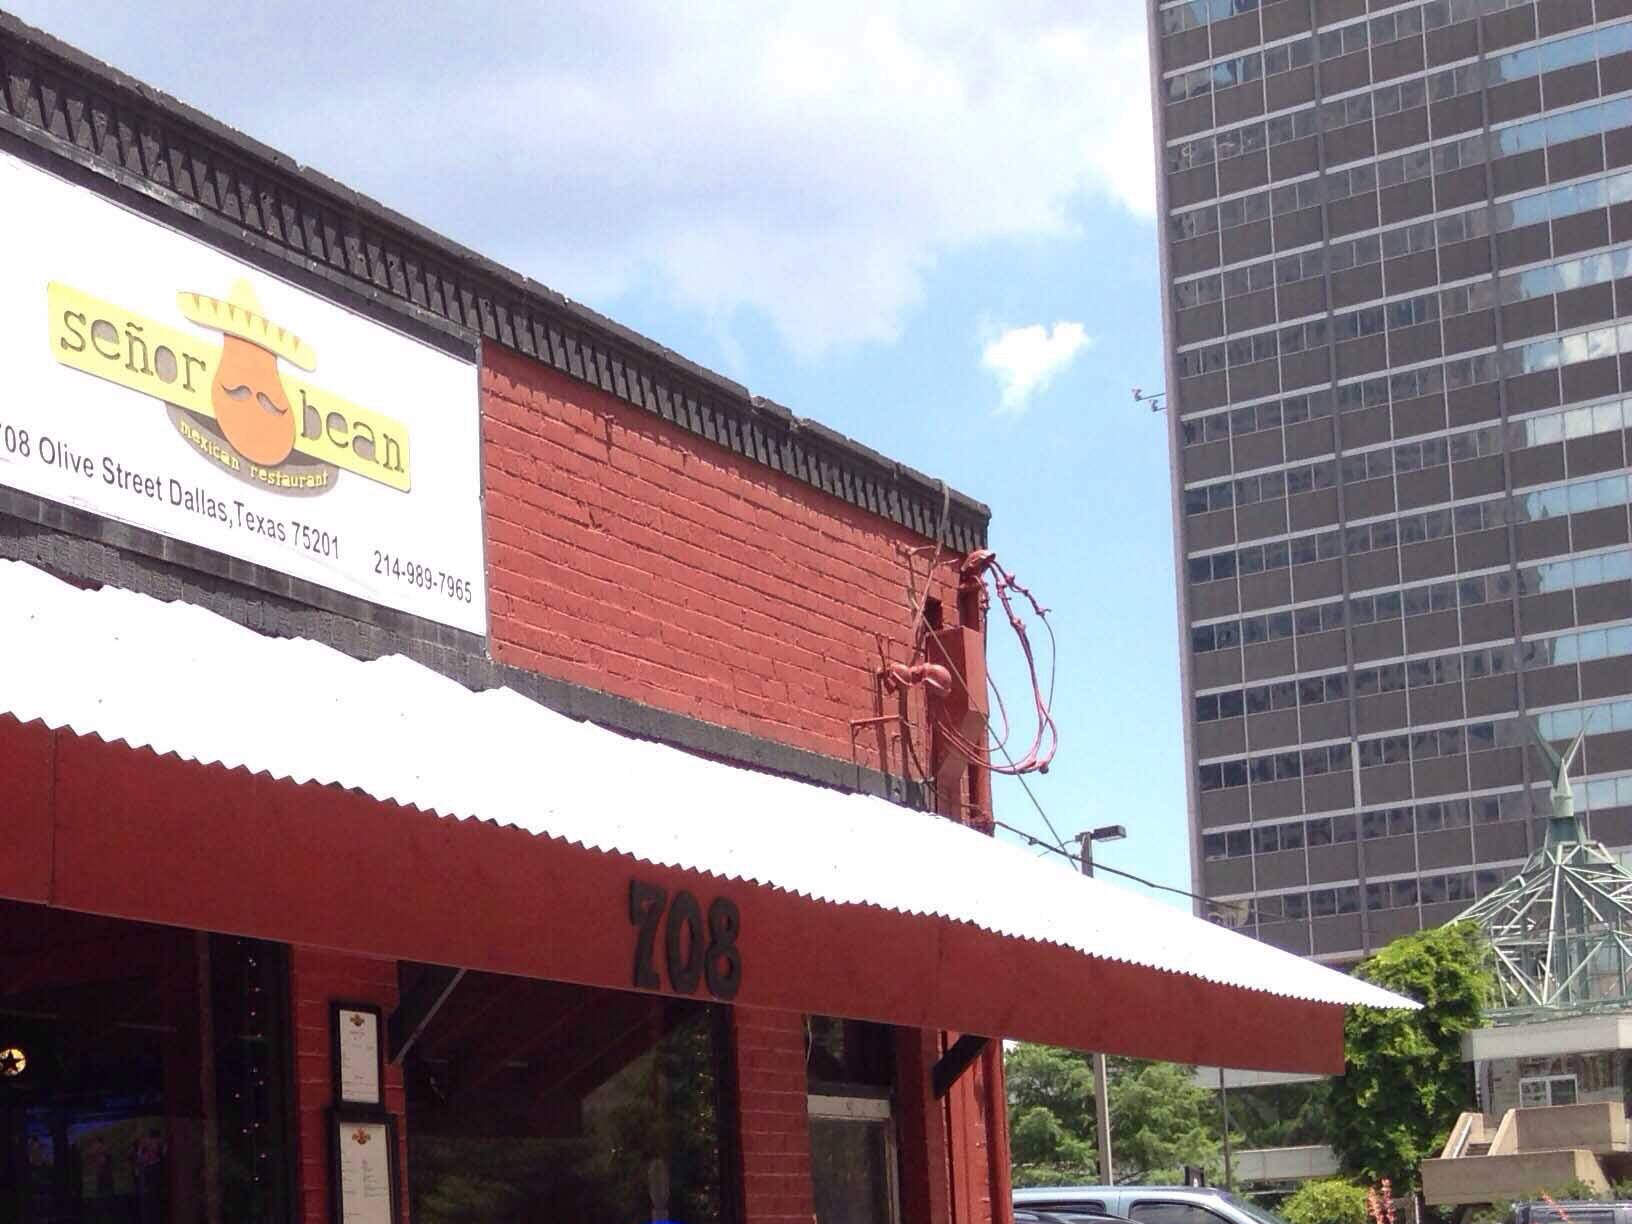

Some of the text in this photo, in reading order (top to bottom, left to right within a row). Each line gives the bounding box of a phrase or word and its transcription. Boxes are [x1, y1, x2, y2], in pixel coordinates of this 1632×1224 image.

[60, 310, 405, 473] señor bean
[39, 436, 94, 478] Olive
[102, 457, 163, 501] Street
[291, 521, 339, 560] 75201
[179, 419, 329, 489] mexican restaurant
[374, 550, 472, 604] 214-989-7965
[629, 879, 743, 998] 708
